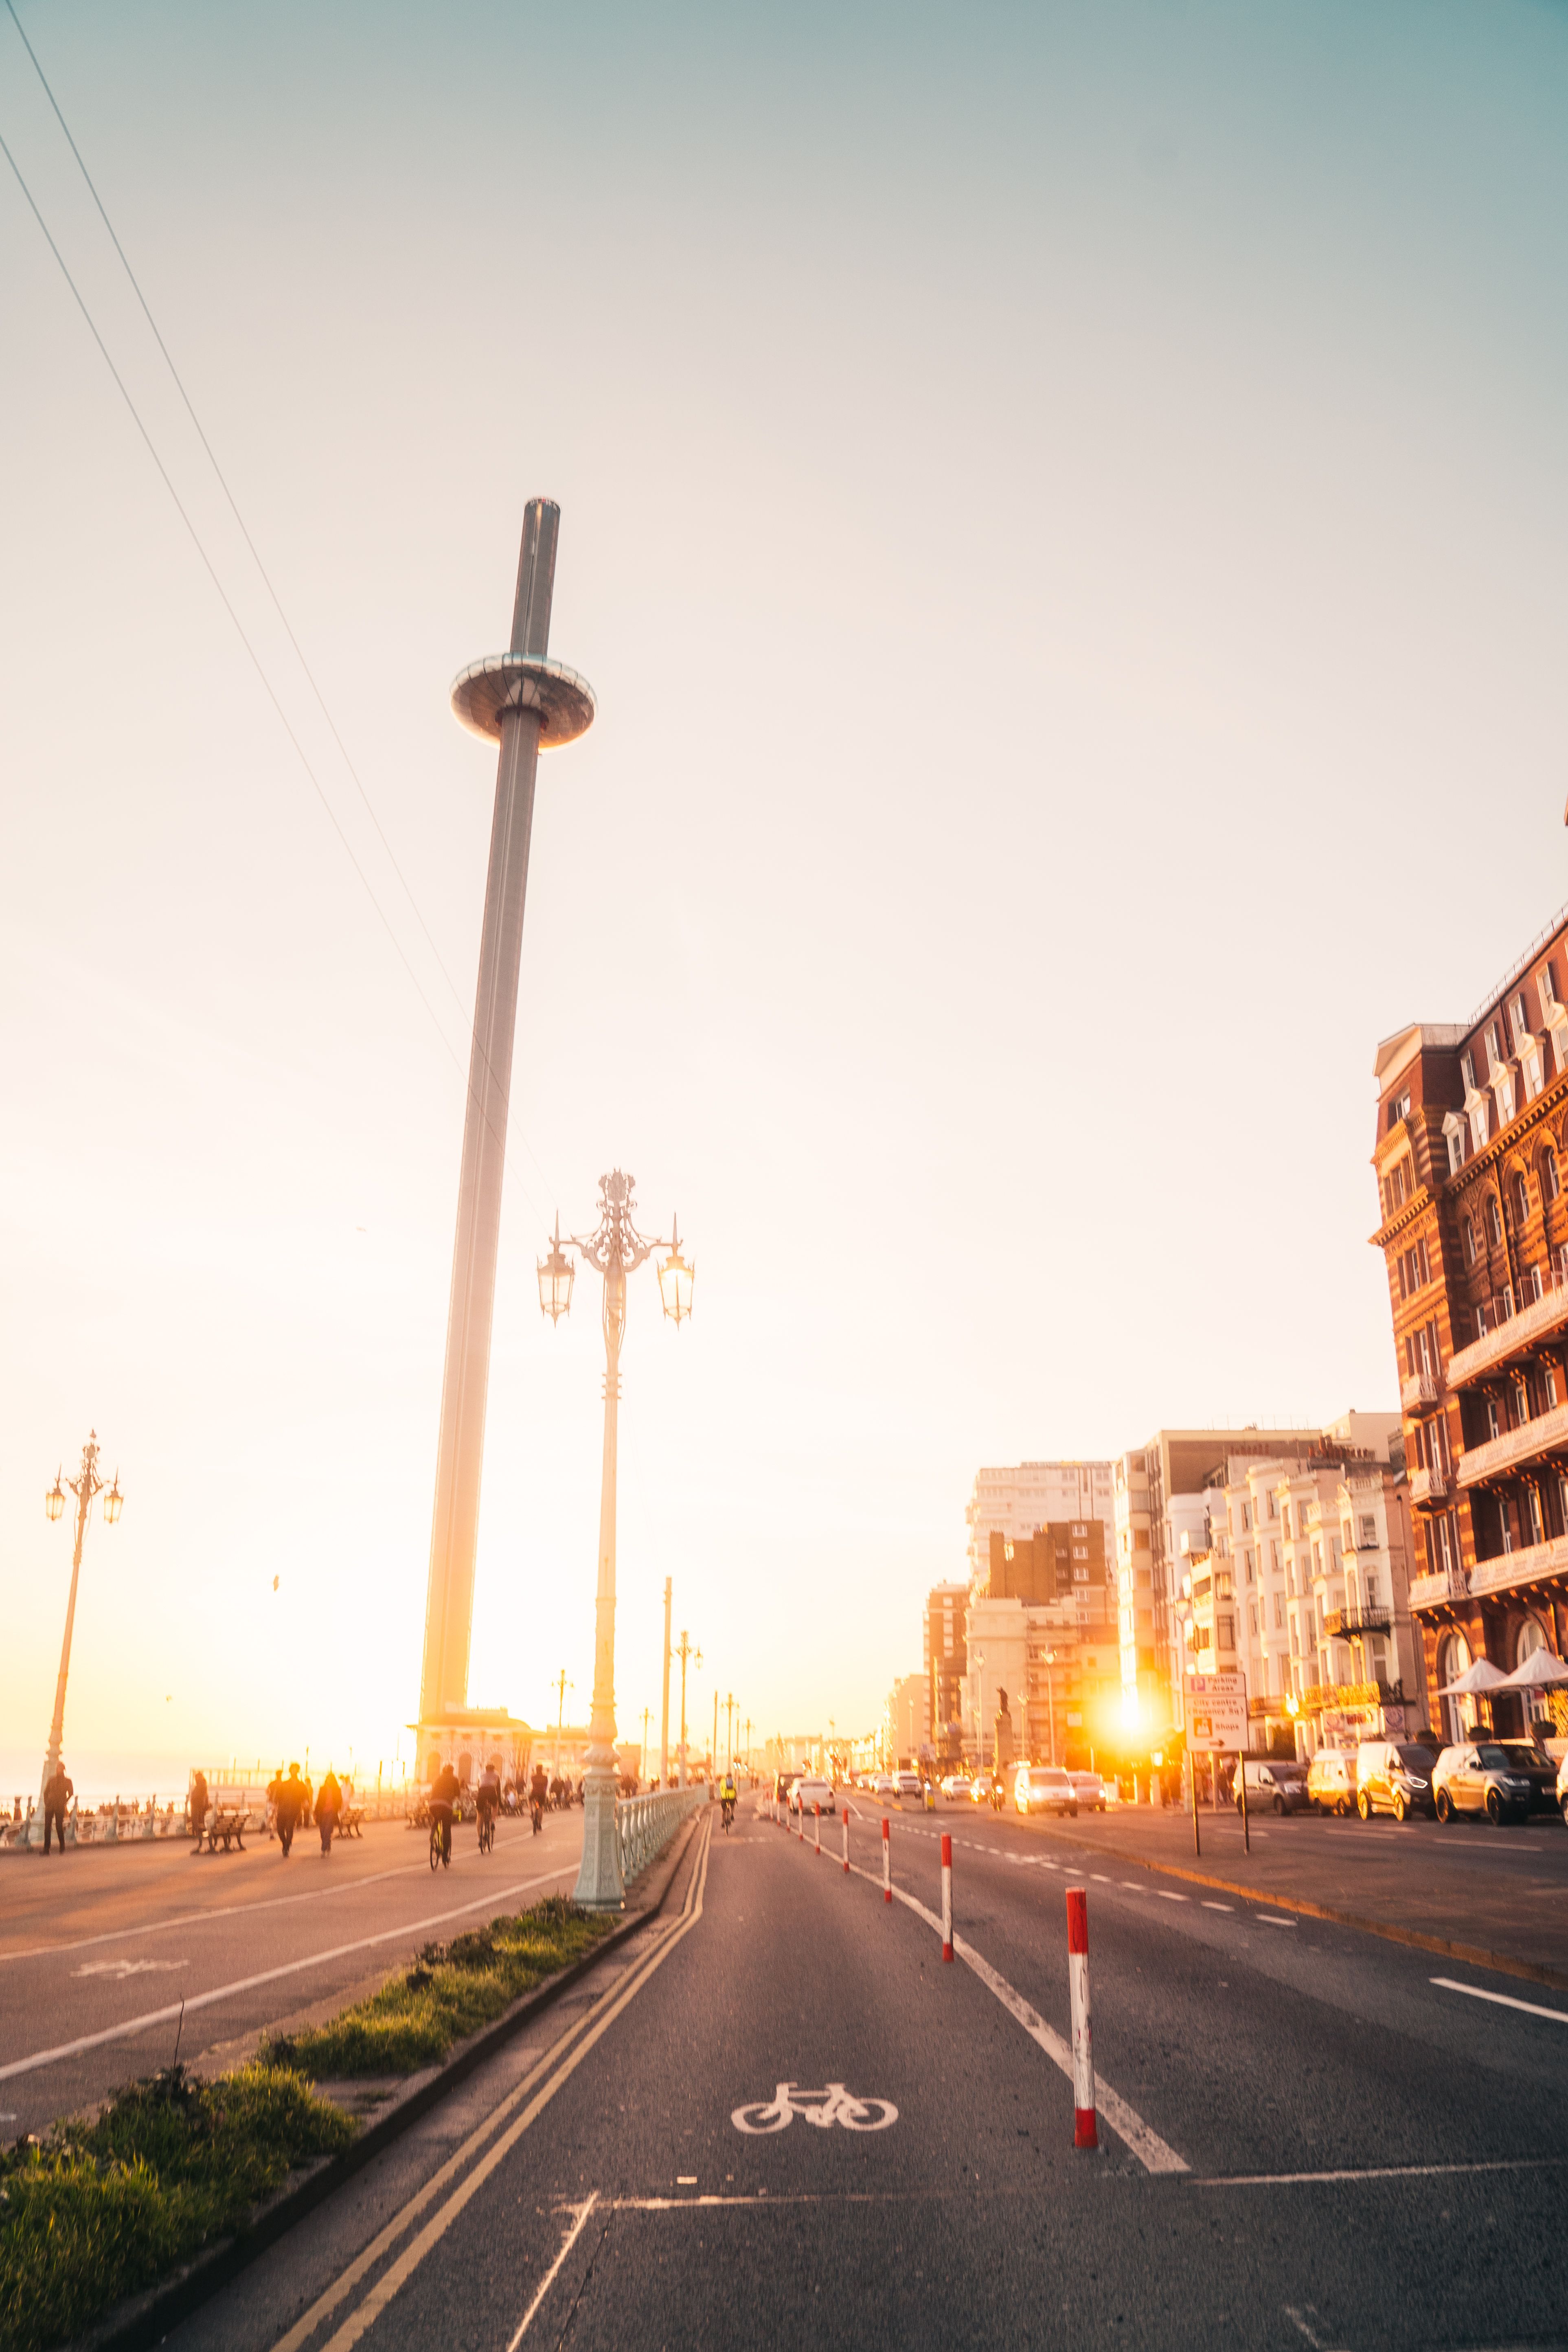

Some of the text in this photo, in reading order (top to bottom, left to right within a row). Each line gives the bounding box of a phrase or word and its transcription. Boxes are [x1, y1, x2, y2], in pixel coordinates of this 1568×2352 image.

[1208, 1676, 1237, 1684] Parking
[1193, 1698, 1237, 1707] City centre
[1188, 1706, 1243, 1716] (Regency Sq)
[1215, 1722, 1239, 1731] Shops
